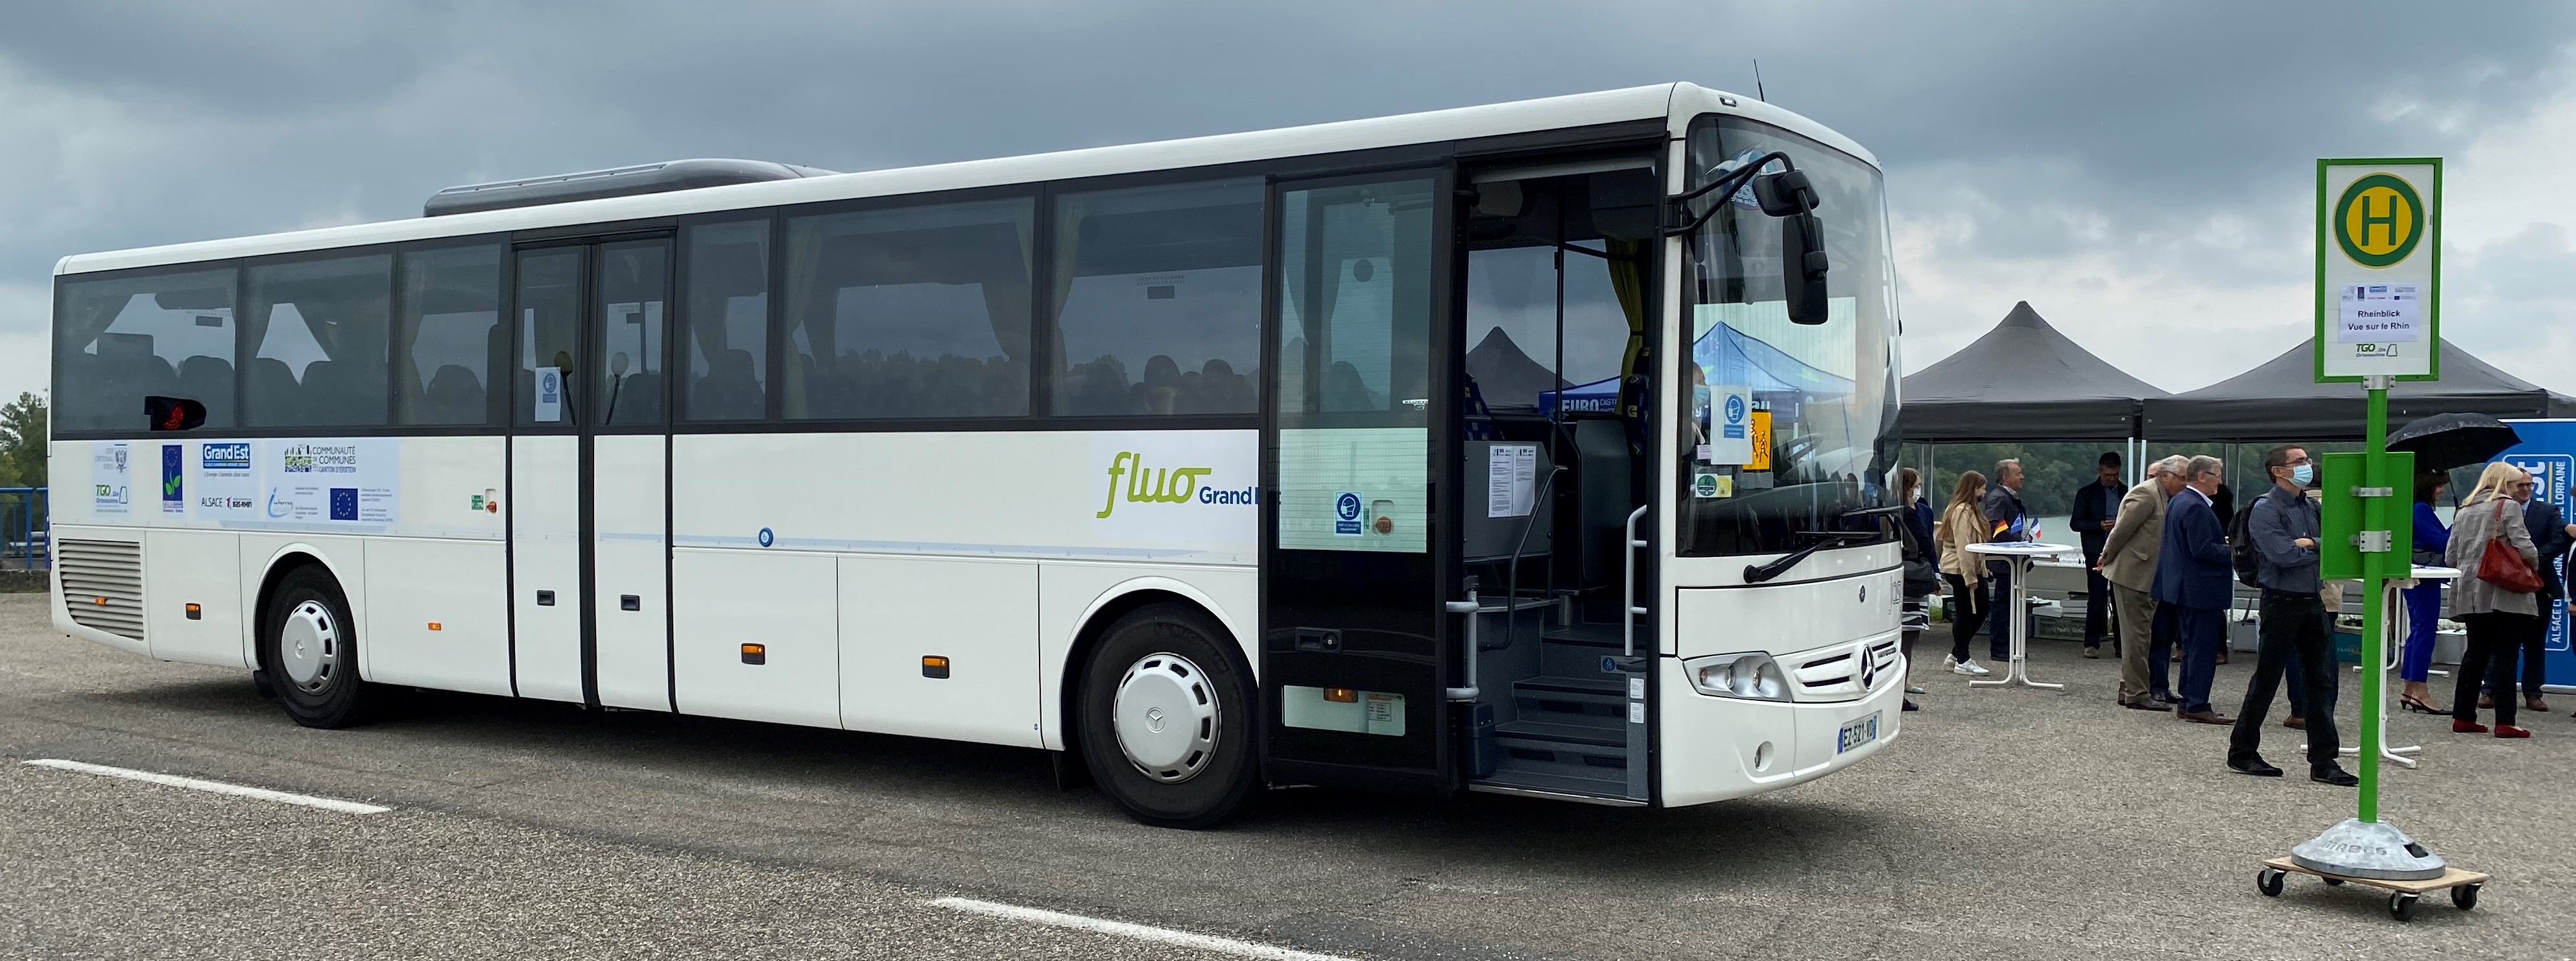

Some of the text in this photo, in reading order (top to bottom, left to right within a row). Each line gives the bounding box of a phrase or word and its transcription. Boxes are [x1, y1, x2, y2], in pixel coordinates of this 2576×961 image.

[2361, 195, 2397, 246] H
[2355, 343, 2376, 352] TGO
[1562, 399, 1599, 412] EURO
[204, 445, 249, 460] Grand Est
[312, 444, 356, 455] COMMUNAUTÉ
[319, 455, 356, 465] COMMUNES
[1096, 451, 1212, 519] fluo
[1199, 486, 1252, 504] Grand
[2555, 461, 2566, 505] LORRAINE
[96, 484, 111, 496] TGO
[201, 497, 223, 508] ALSACE
[2551, 608, 2562, 644] ALSACE
